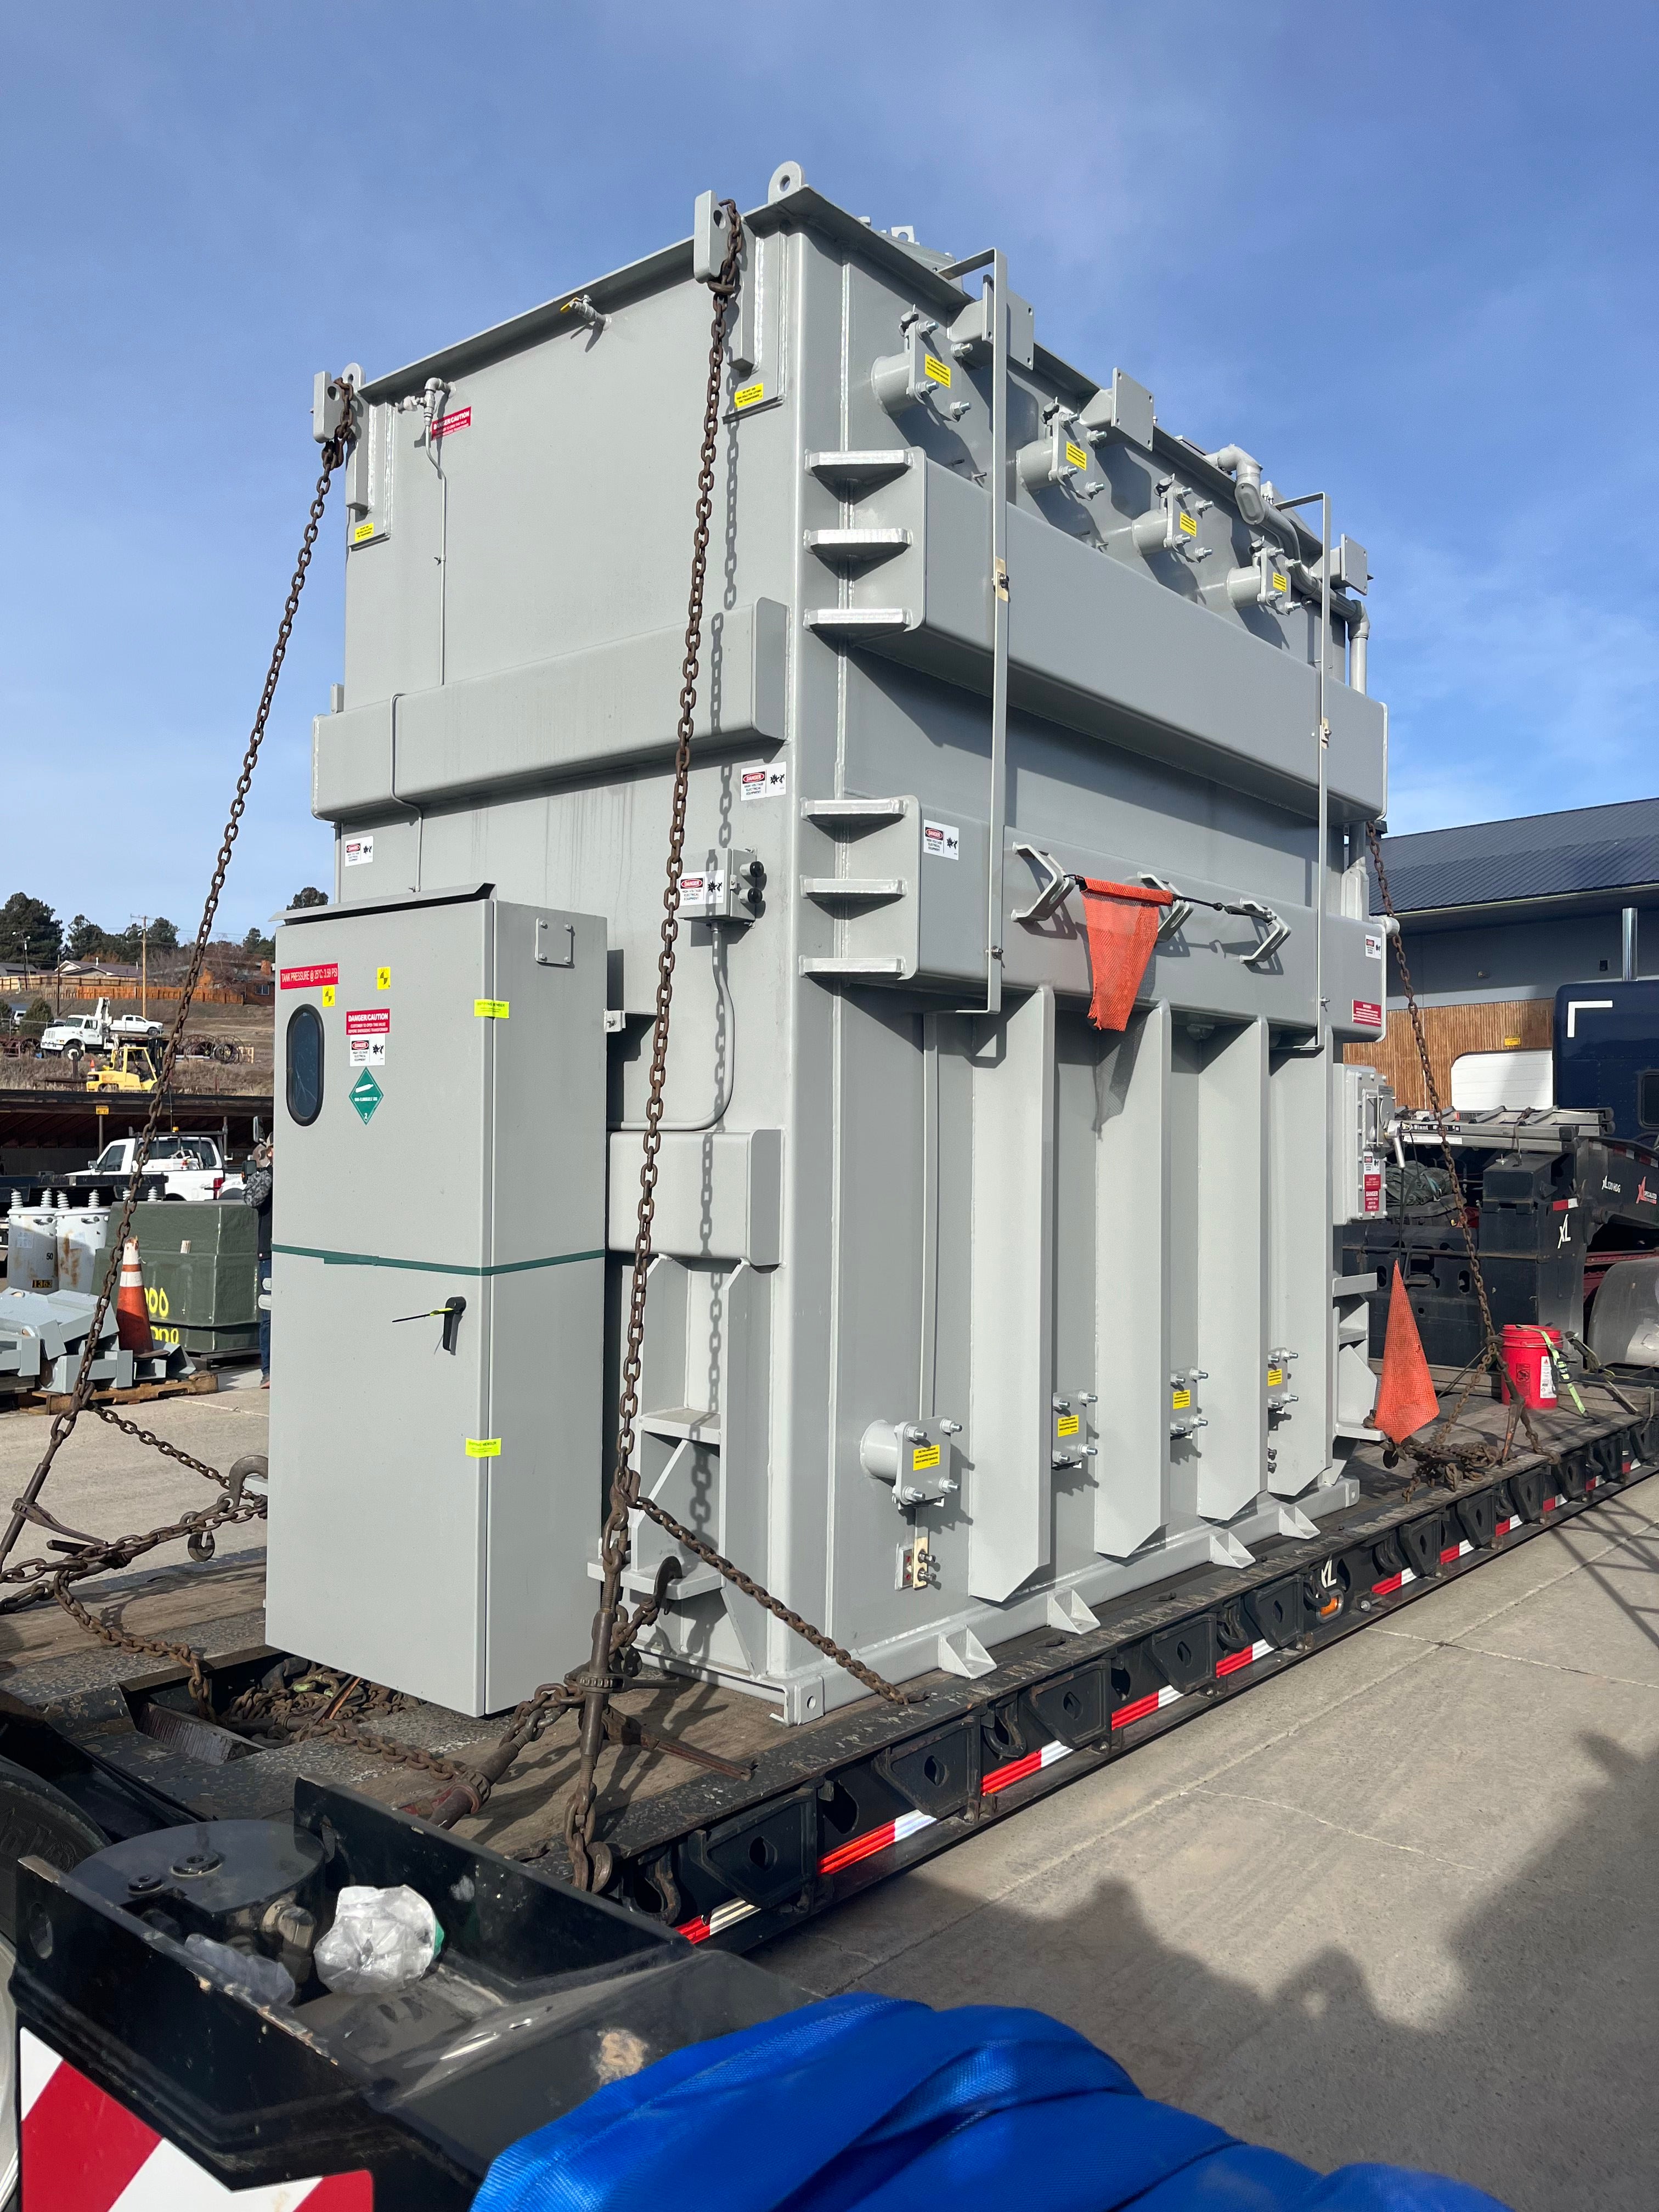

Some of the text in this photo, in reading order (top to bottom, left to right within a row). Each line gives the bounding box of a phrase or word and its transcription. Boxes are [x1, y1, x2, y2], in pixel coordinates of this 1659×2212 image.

[281, 973, 291, 983] TANK
[291, 970, 310, 981] PRESSURE
[310, 969, 314, 982] @
[348, 1013, 388, 1022] DANGER/CAUTION
[1558, 1214, 1571, 1249] XL
